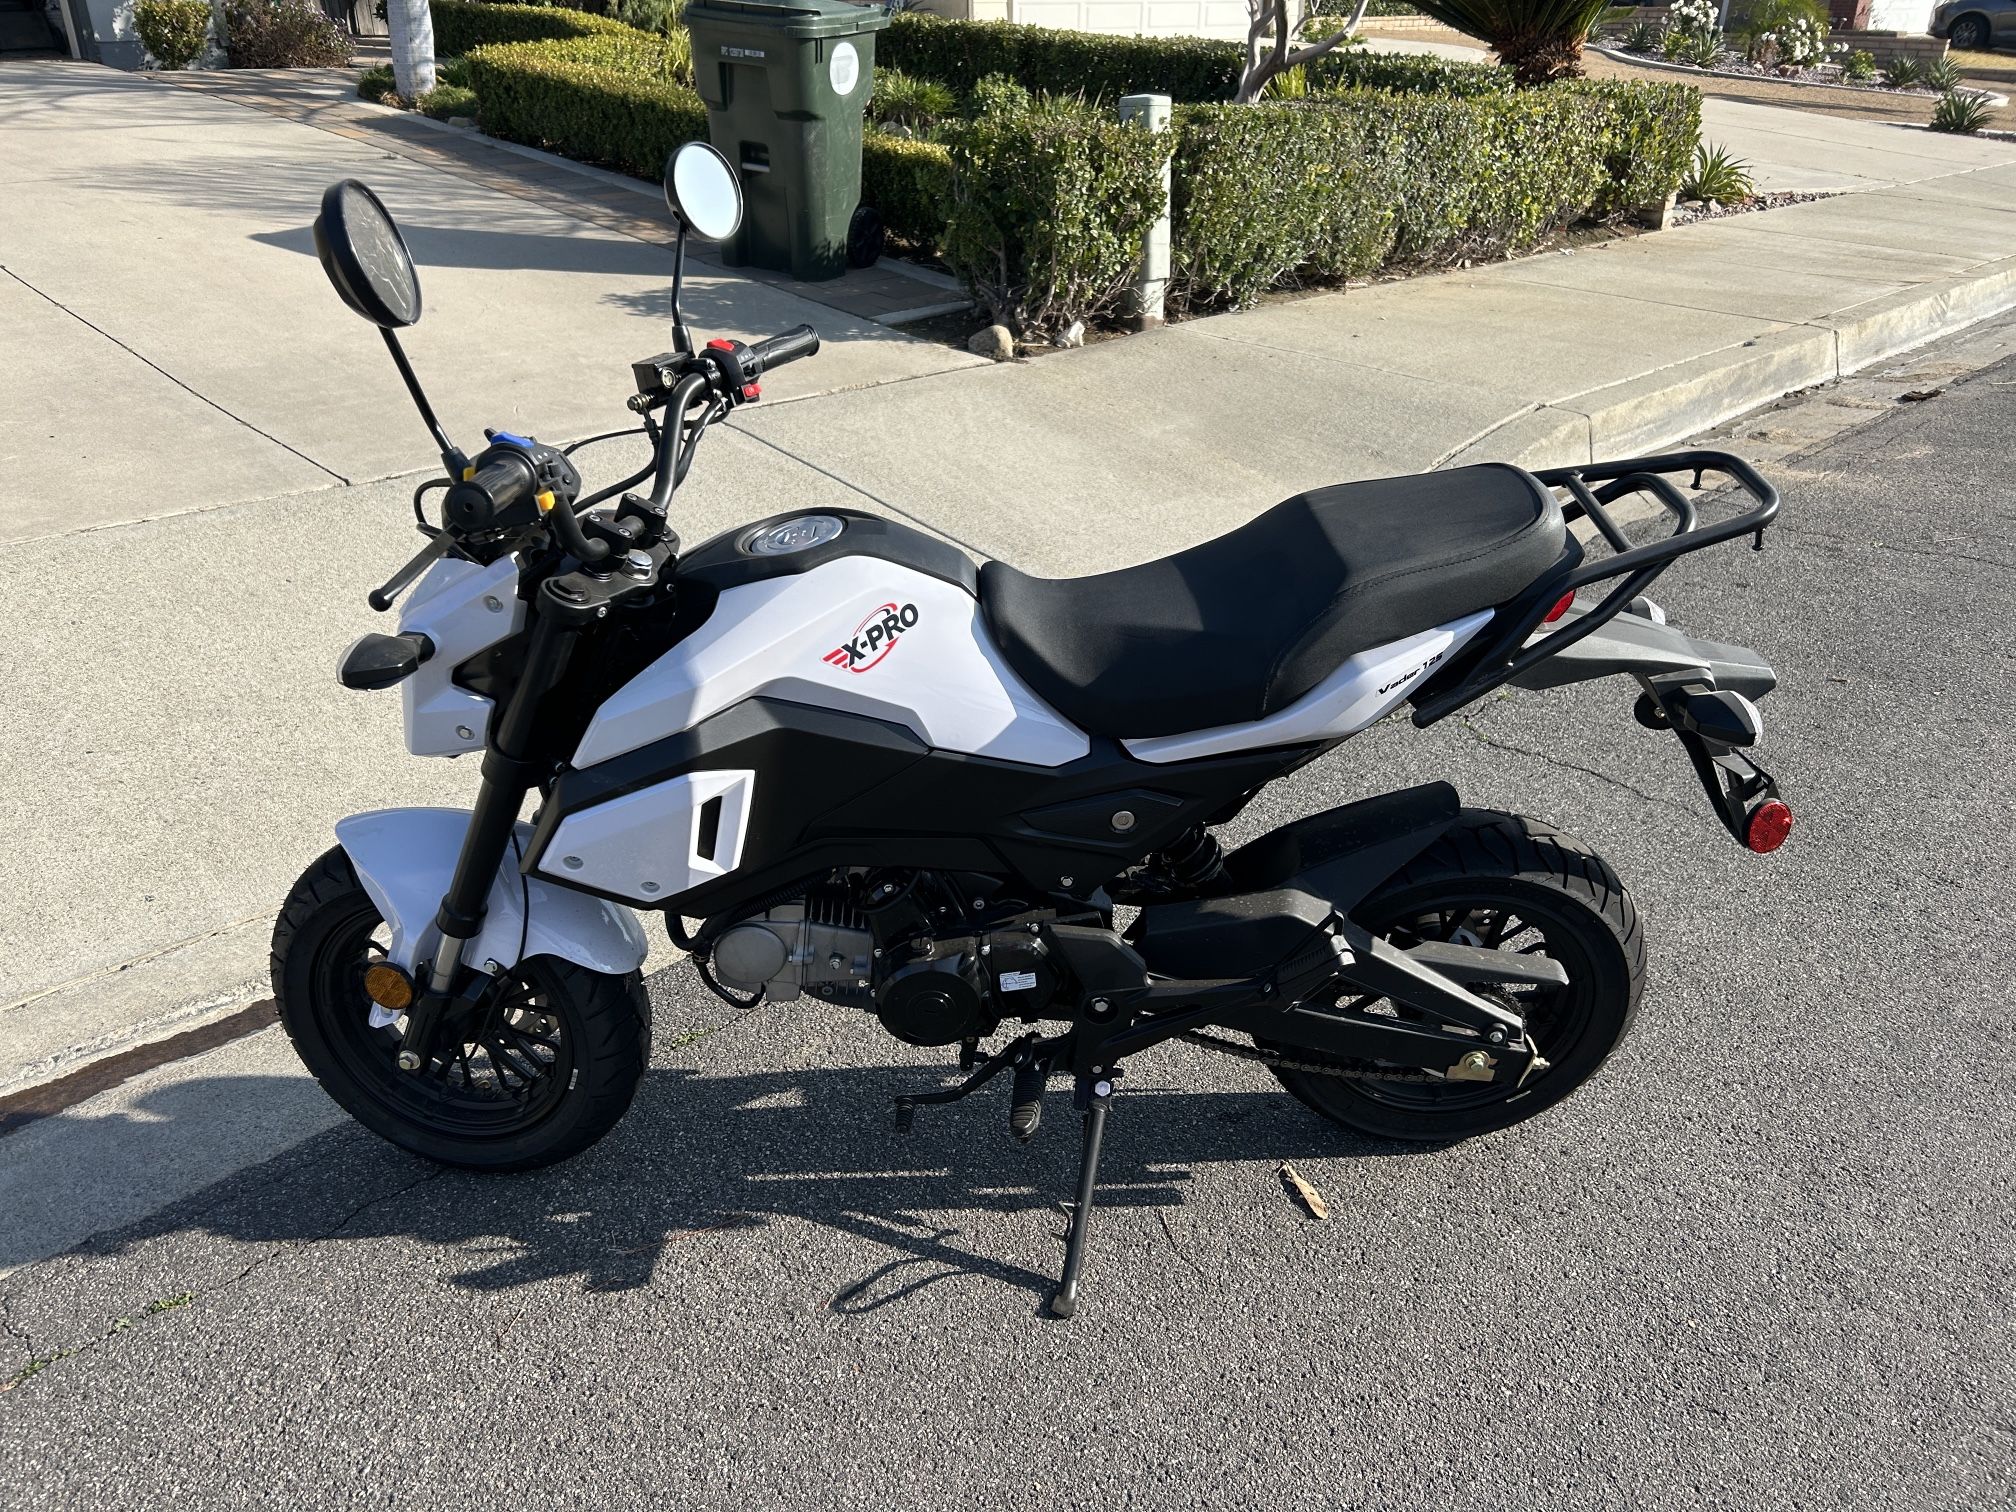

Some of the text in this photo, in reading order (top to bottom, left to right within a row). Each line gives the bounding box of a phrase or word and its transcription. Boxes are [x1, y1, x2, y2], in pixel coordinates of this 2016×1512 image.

[841, 603, 919, 667] X-PRO
[1378, 651, 1443, 694] Vader 125
